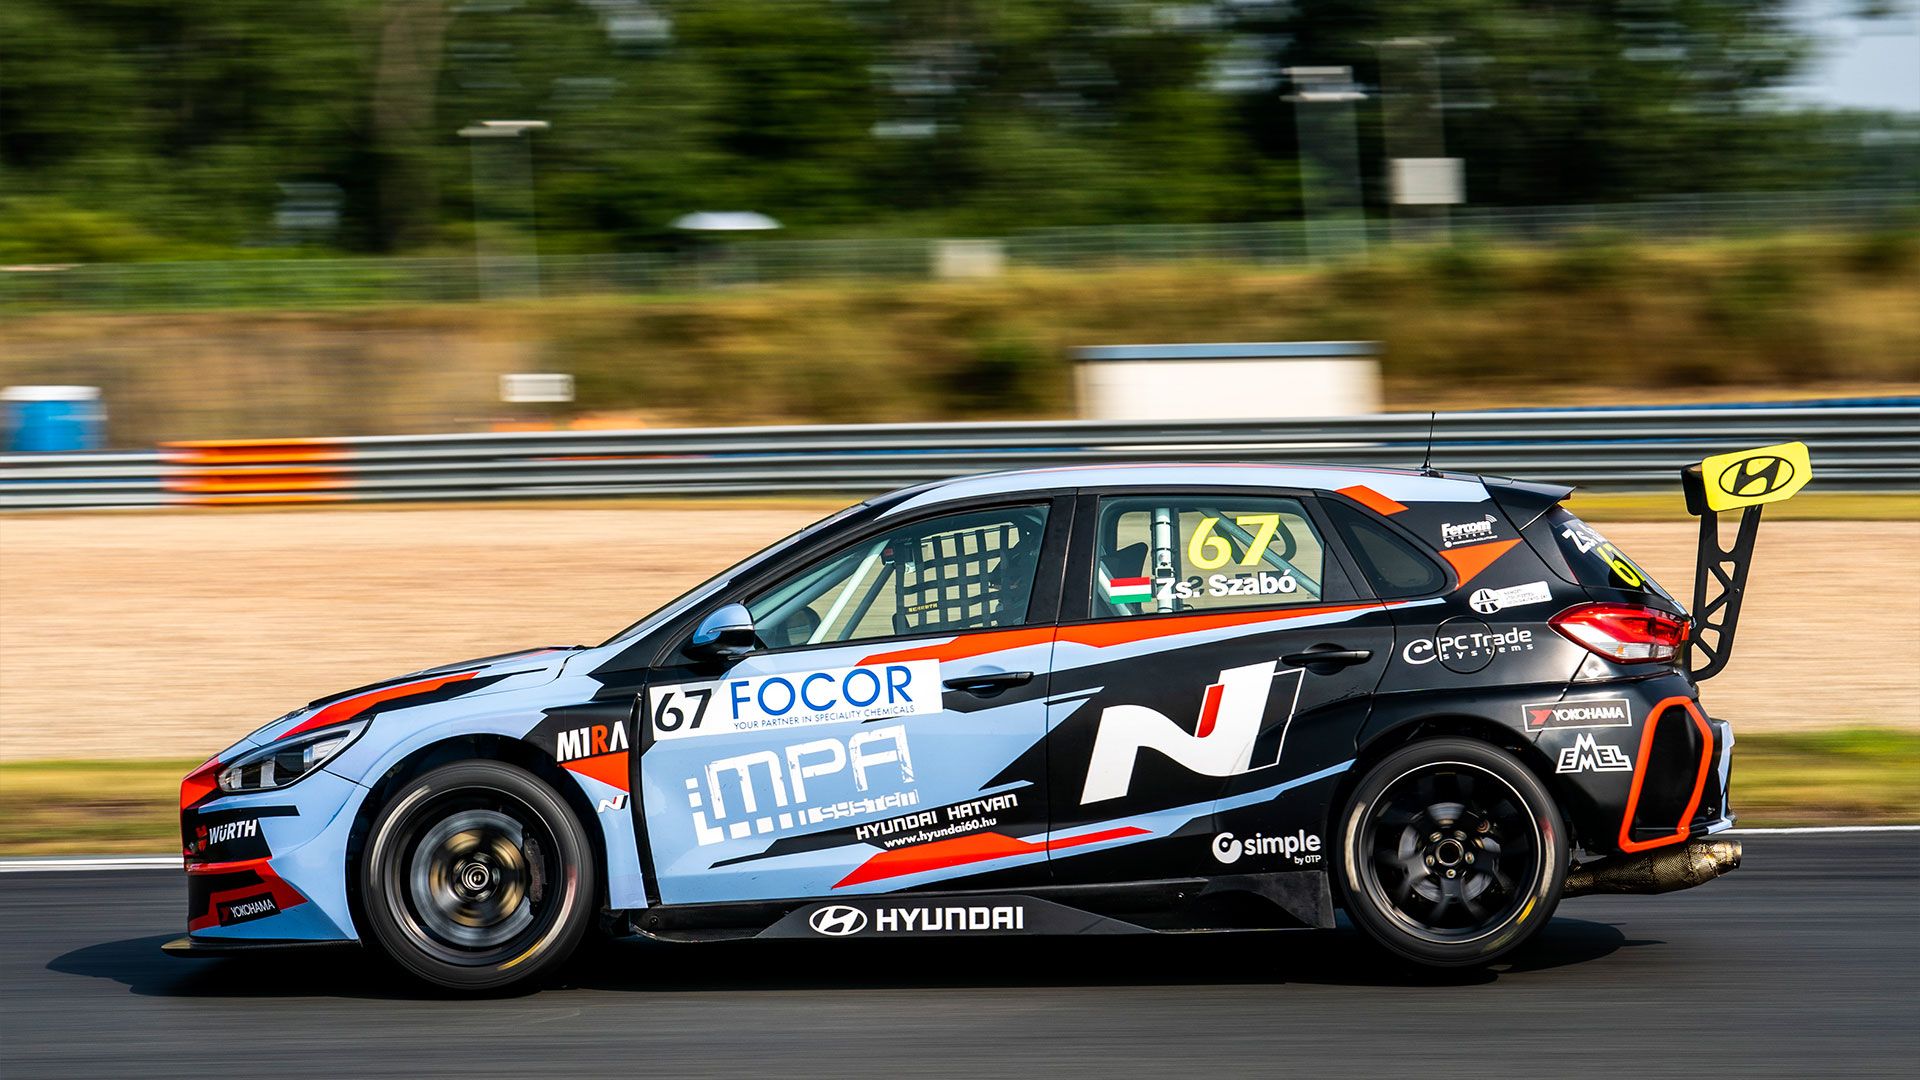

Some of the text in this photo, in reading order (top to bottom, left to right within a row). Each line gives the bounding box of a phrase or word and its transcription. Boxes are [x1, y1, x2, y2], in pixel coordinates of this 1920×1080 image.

[1187, 514, 1280, 570] 67
[1156, 569, 1297, 601] Zs. Szabó
[1440, 627, 1532, 652] PC Trade
[1443, 644, 1534, 660] systems
[654, 665, 913, 732] 67 FOCOR
[734, 705, 915, 730] YOUR PARTNER IN SPECIALITY CHEMICALS
[1552, 706, 1625, 721] YOKOHAMA
[855, 793, 1018, 841] HYUNDAI HATVAN
[884, 817, 997, 848] www.hyundai60.hu
[1244, 829, 1321, 859] simple
[1294, 854, 1321, 866] by OTP
[230, 899, 275, 918] YOKOHAMA
[876, 906, 1024, 932] HYUNDAI
